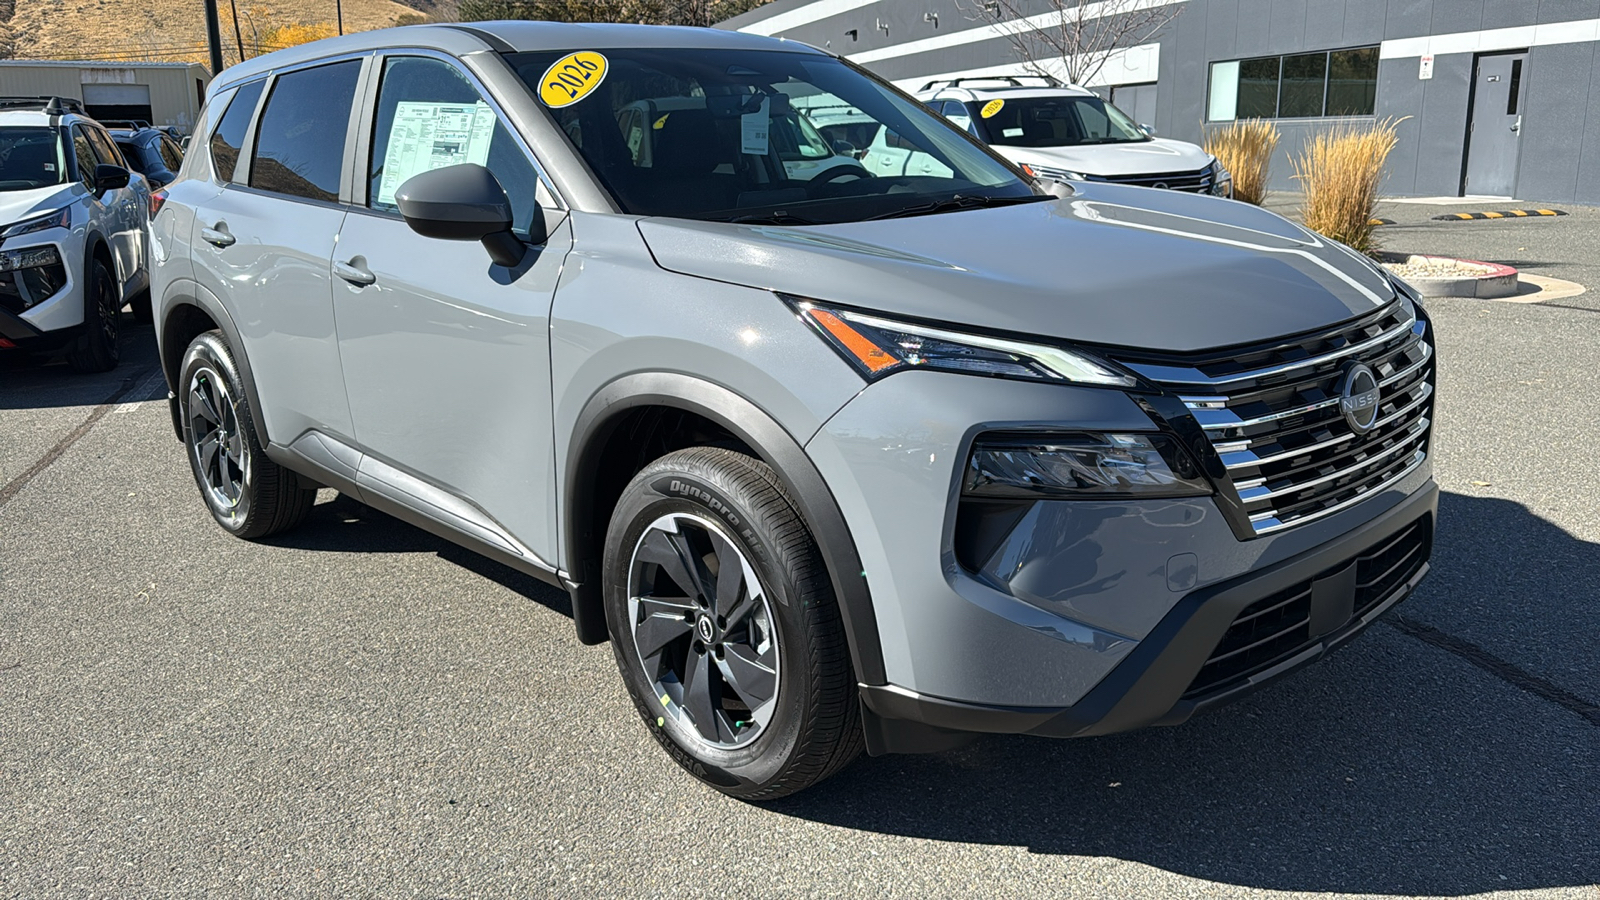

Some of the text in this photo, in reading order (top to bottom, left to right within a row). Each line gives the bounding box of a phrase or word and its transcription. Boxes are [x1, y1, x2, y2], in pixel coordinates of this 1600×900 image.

[549, 56, 598, 98] 2026
[985, 101, 1000, 114] 2026
[670, 480, 740, 526] Dynapro
